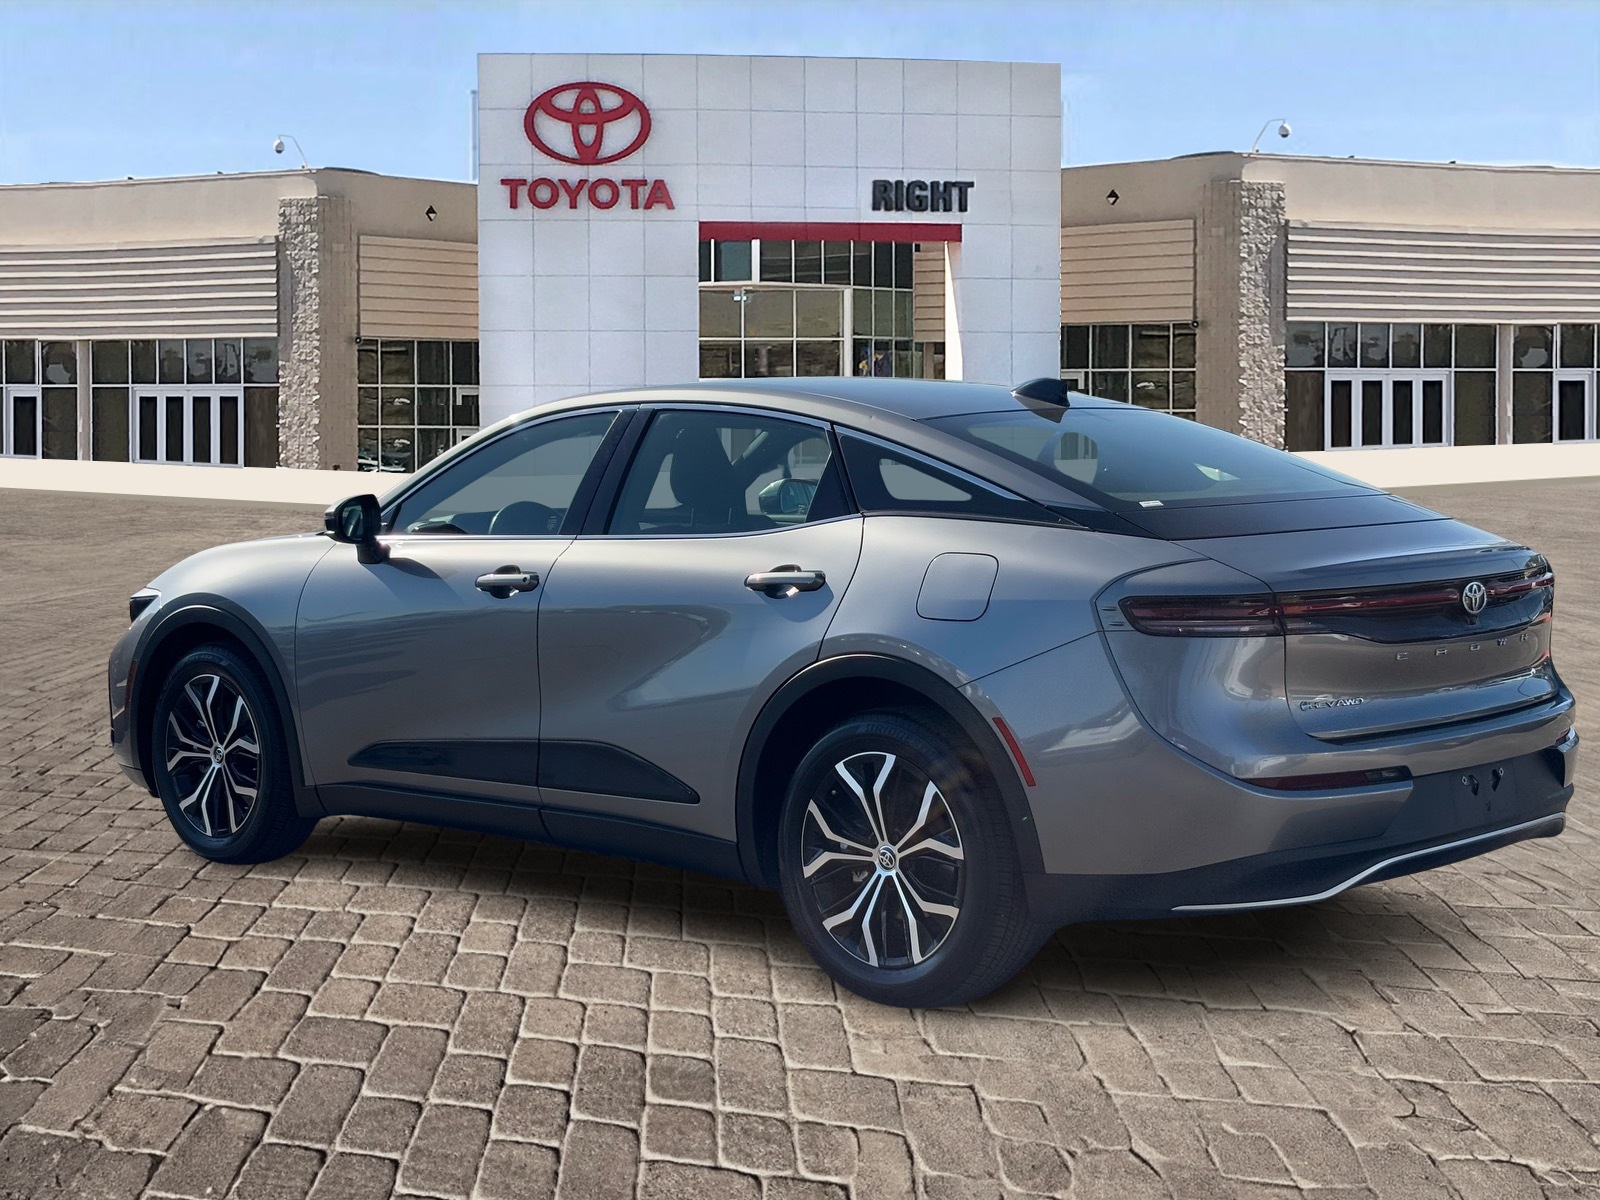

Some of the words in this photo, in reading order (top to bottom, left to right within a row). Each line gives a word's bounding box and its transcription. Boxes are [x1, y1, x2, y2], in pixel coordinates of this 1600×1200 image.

[500, 178, 675, 210] TOYOTA
[872, 180, 975, 213] RIGHT
[1396, 633, 1530, 661] CROWN
